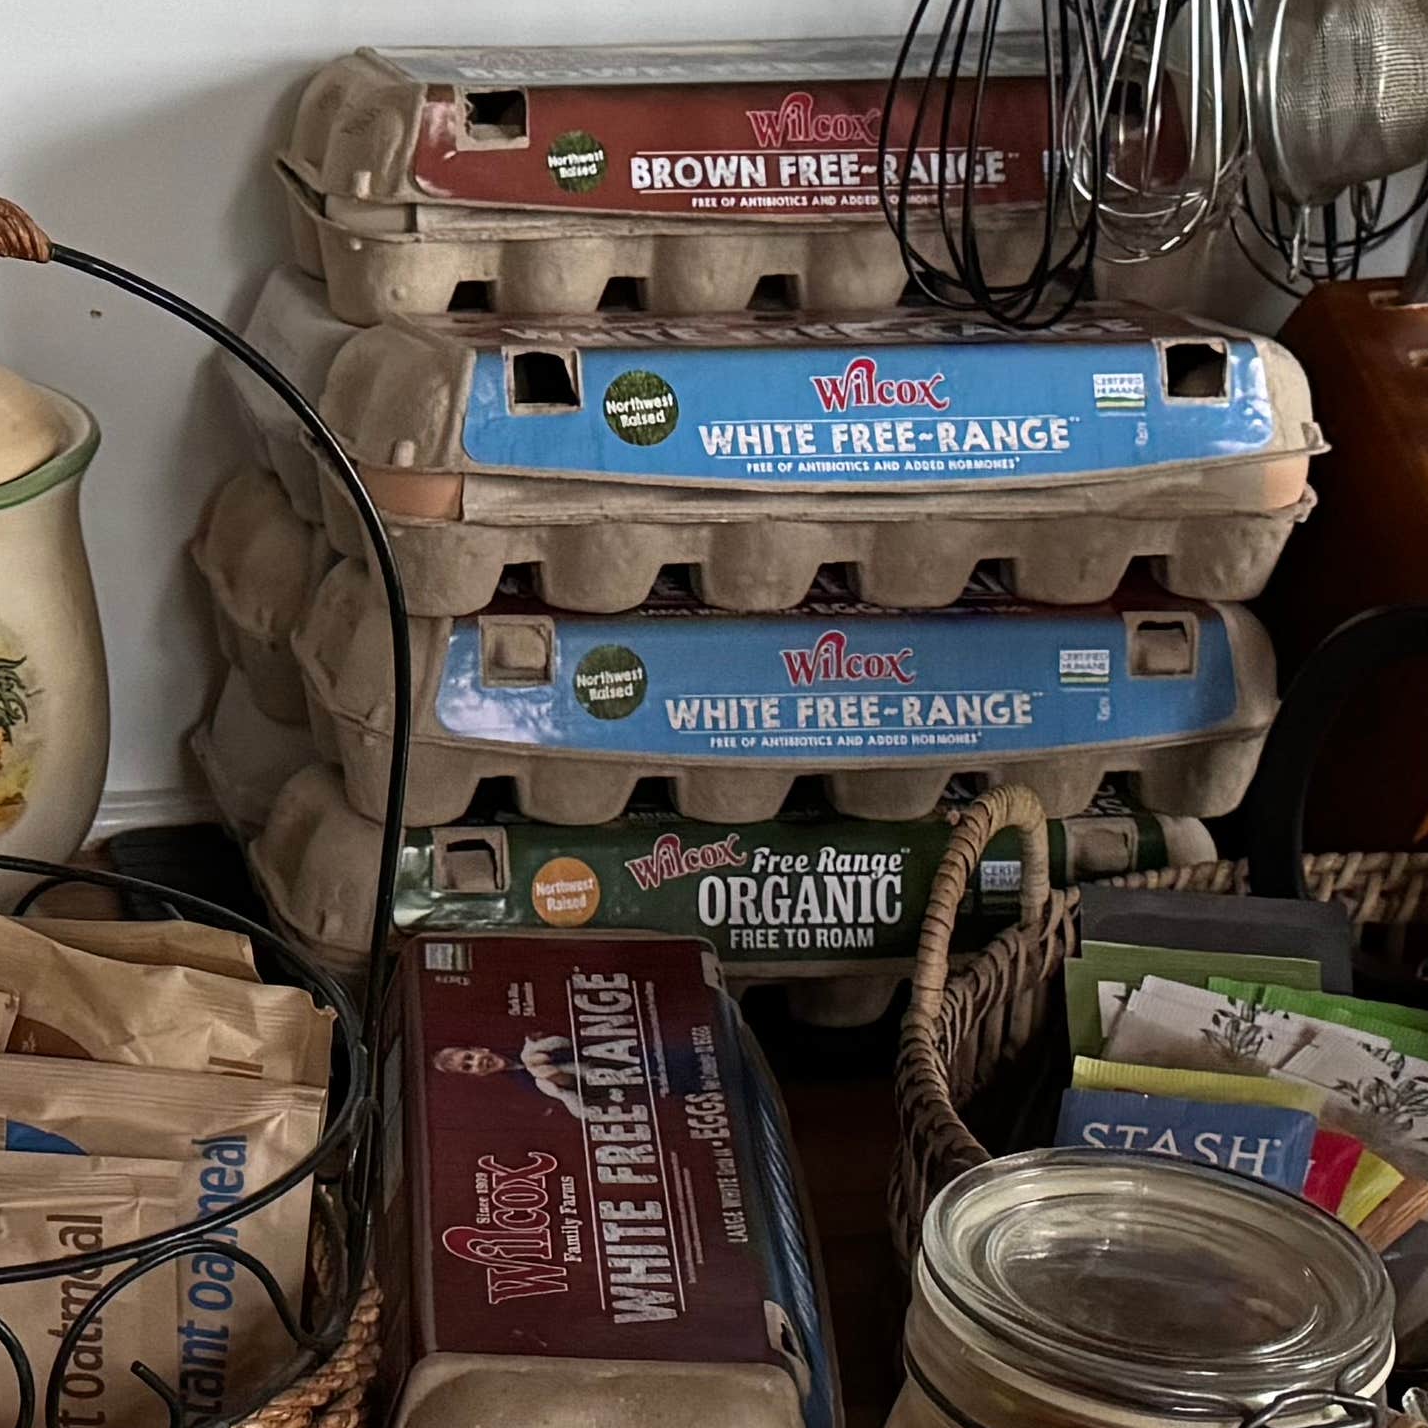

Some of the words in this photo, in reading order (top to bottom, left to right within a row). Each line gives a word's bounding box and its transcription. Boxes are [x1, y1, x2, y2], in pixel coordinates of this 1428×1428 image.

[745, 91, 883, 149] Wilcox
[630, 155, 767, 189] BROWN
[691, 197, 717, 208] FREE
[721, 197, 735, 207] OF
[740, 195, 808, 207] ANTIBIOTICS
[812, 195, 837, 206] AND
[840, 194, 879, 206] ADDED
[809, 356, 950, 412] Wilcox
[606, 393, 674, 415] Northwest
[620, 410, 666, 428] Raised
[698, 423, 817, 456] WHITE
[746, 462, 773, 473] FREE
[777, 462, 792, 472] OF
[798, 461, 870, 472] ANTIBIOTICS
[874, 459, 900, 471] AND
[904, 458, 945, 471] ADDED
[779, 629, 916, 687] Wilcox
[576, 667, 644, 688] Northwest
[589, 683, 634, 701] Raised
[665, 696, 781, 731] WHITE
[710, 737, 737, 748] FREE
[741, 737, 756, 747] OF
[761, 735, 832, 747] ANTIBIOTICS
[837, 735, 863, 747] AND
[867, 734, 908, 746] ADDED
[624, 833, 748, 891] Wilcox
[751, 847, 810, 874] Free
[816, 846, 904, 879] Range
[536, 876, 595, 898] Northwest
[546, 894, 588, 913] Raised
[698, 874, 903, 927] ORGANIC
[730, 928, 779, 949] FREE
[784, 928, 811, 948] TO
[815, 927, 875, 949] ROAM
[684, 1091, 730, 1140] EGGS
[560, 1176, 578, 1210] Farms
[475, 1197, 491, 1225] Since
[442, 1151, 568, 1305] Wilcox
[560, 1212, 583, 1264] Family
[598, 1200, 678, 1324] WHITE
